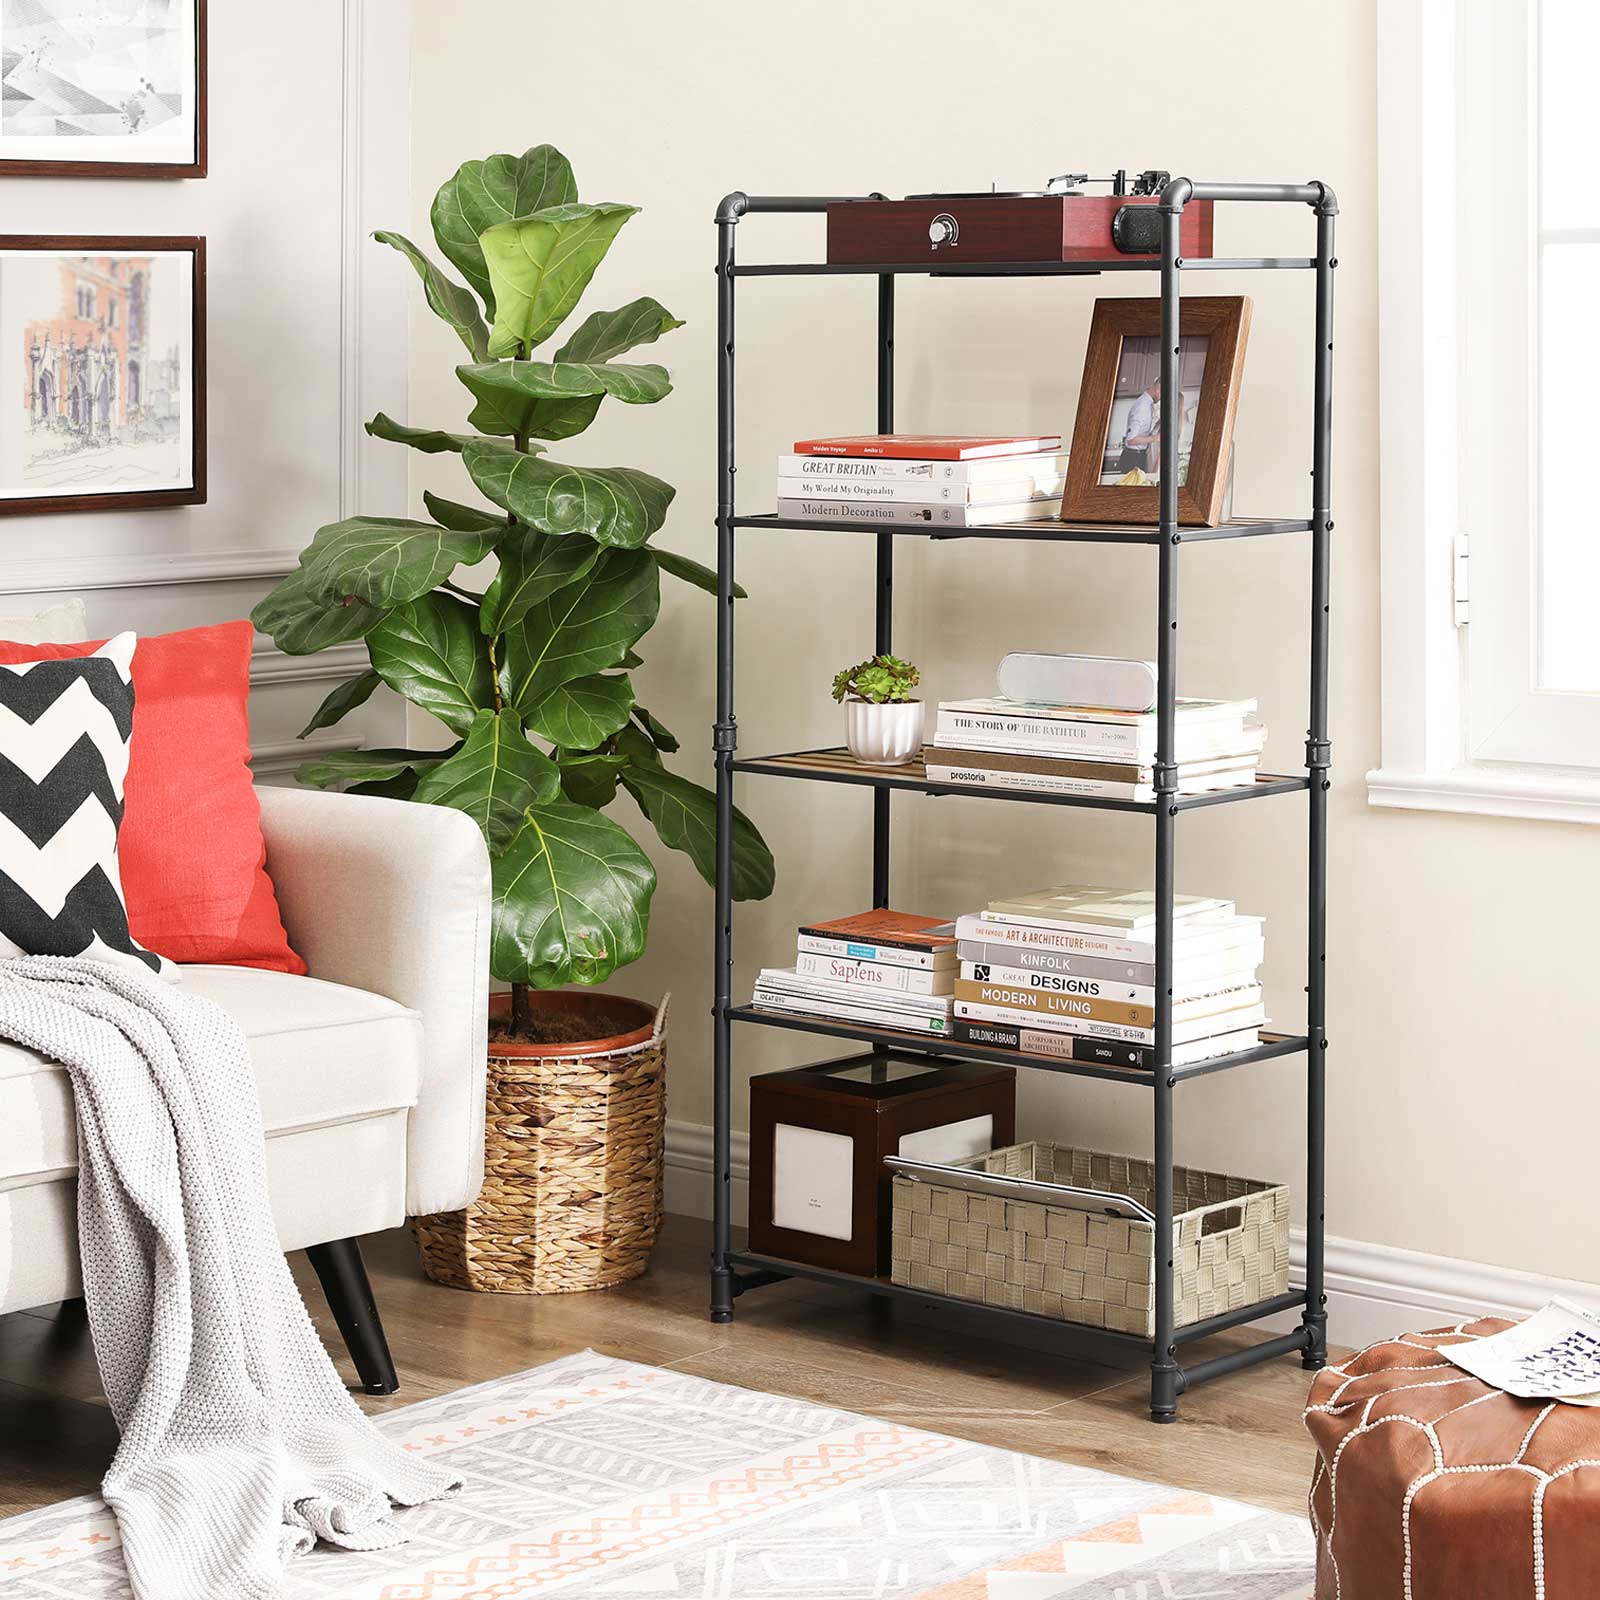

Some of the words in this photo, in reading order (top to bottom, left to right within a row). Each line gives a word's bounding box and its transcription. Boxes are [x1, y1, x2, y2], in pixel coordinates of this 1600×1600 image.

[802, 461, 836, 474] GREAT
[837, 463, 878, 476] BRITAIN
[801, 484, 813, 493] My
[815, 484, 838, 493] World
[840, 485, 852, 495] My
[853, 485, 895, 496] Originality
[801, 503, 839, 516] Modern
[841, 505, 895, 518] Decoration
[953, 718, 973, 729] THE
[975, 720, 1005, 731] STORY
[1007, 723, 1020, 732] OF
[1020, 724, 1041, 734] THE
[1043, 726, 1087, 738] BATHTUB
[950, 771, 986, 782] prostoria
[1006, 930, 1020, 941] ART
[1022, 931, 1027, 942] &
[1029, 932, 1084, 949] ARCHITECTURE
[1020, 953, 1071, 971] KINFOLK
[830, 960, 883, 983] Sapiens
[1030, 974, 1100, 995] DESIGNS
[981, 987, 1037, 1006] MODERN
[1048, 997, 1092, 1014] LIVING
[969, 1028, 994, 1042] BUILDING
[998, 1033, 1018, 1046] BRAND
[1028, 1035, 1064, 1046] CORPORATE
[1024, 1043, 1071, 1055] ARCHITECTURE
